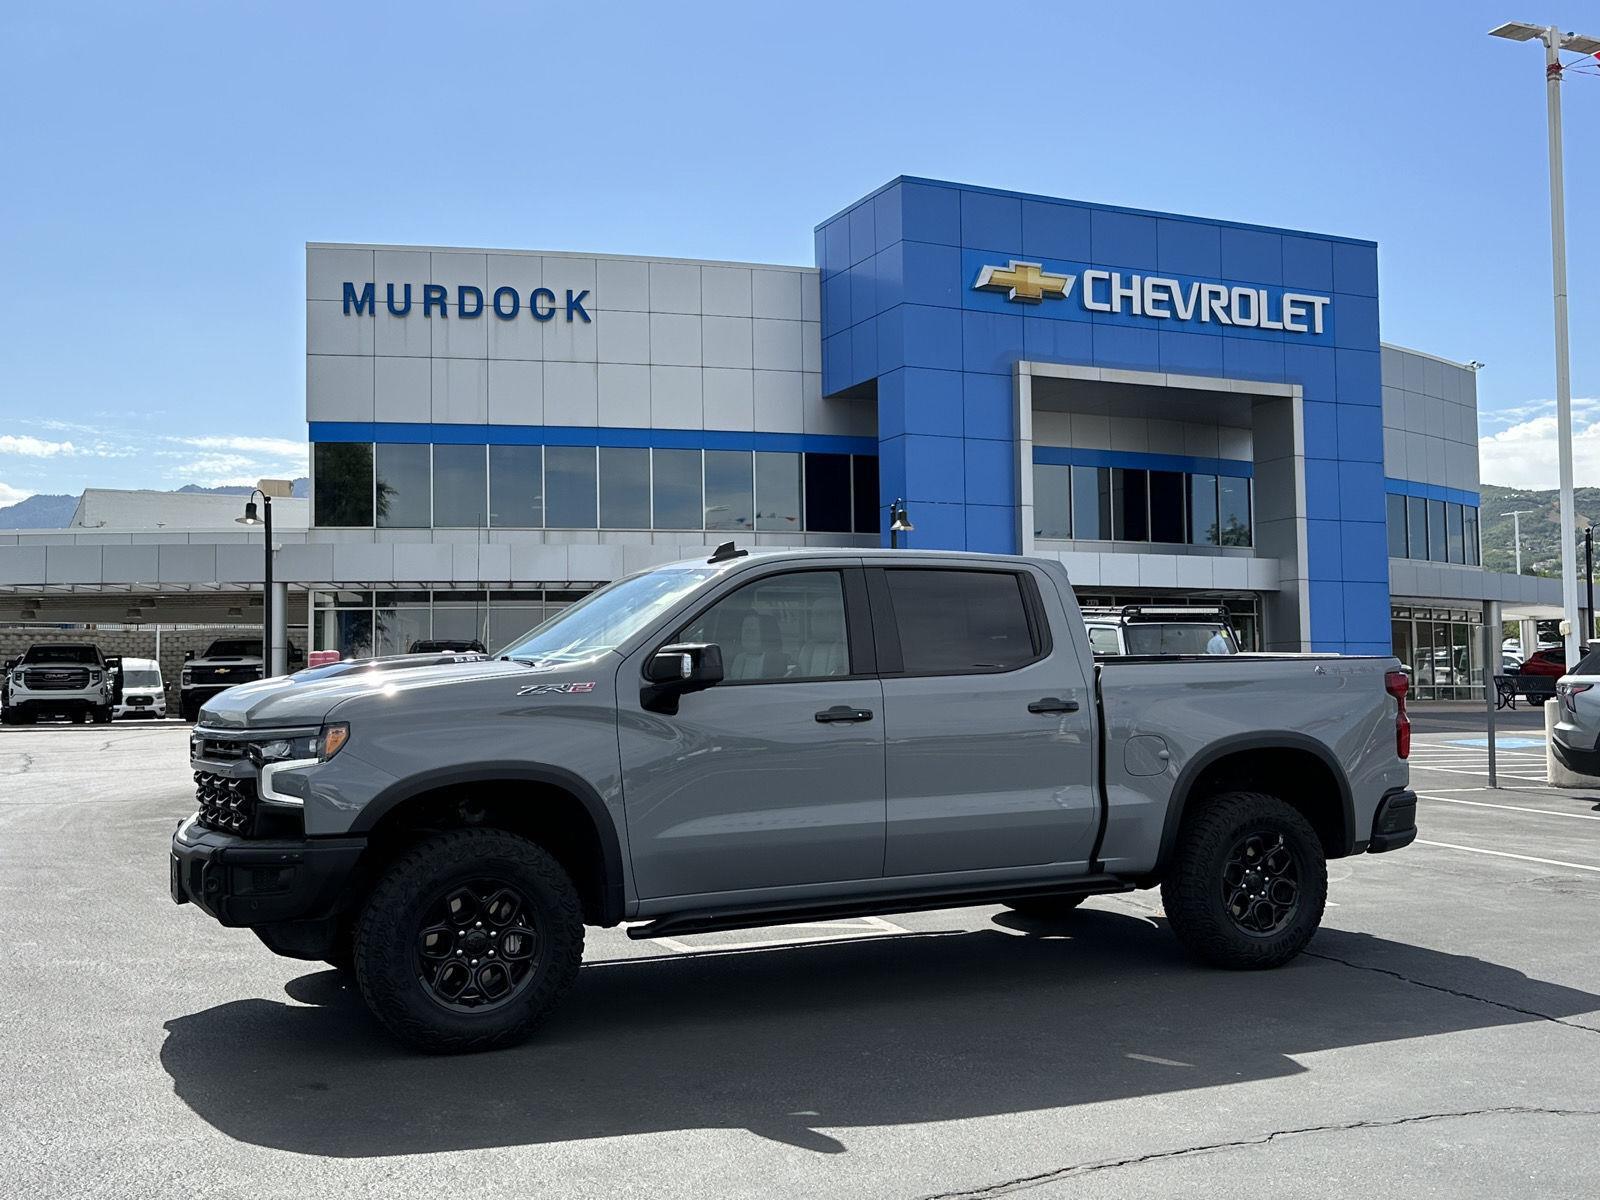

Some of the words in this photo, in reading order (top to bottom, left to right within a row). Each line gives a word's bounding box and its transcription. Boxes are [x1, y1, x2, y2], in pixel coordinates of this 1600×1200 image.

[342, 281, 592, 323] MURDOCK
[1082, 269, 1331, 333] CHEVROLET
[516, 681, 596, 697] ZR2
